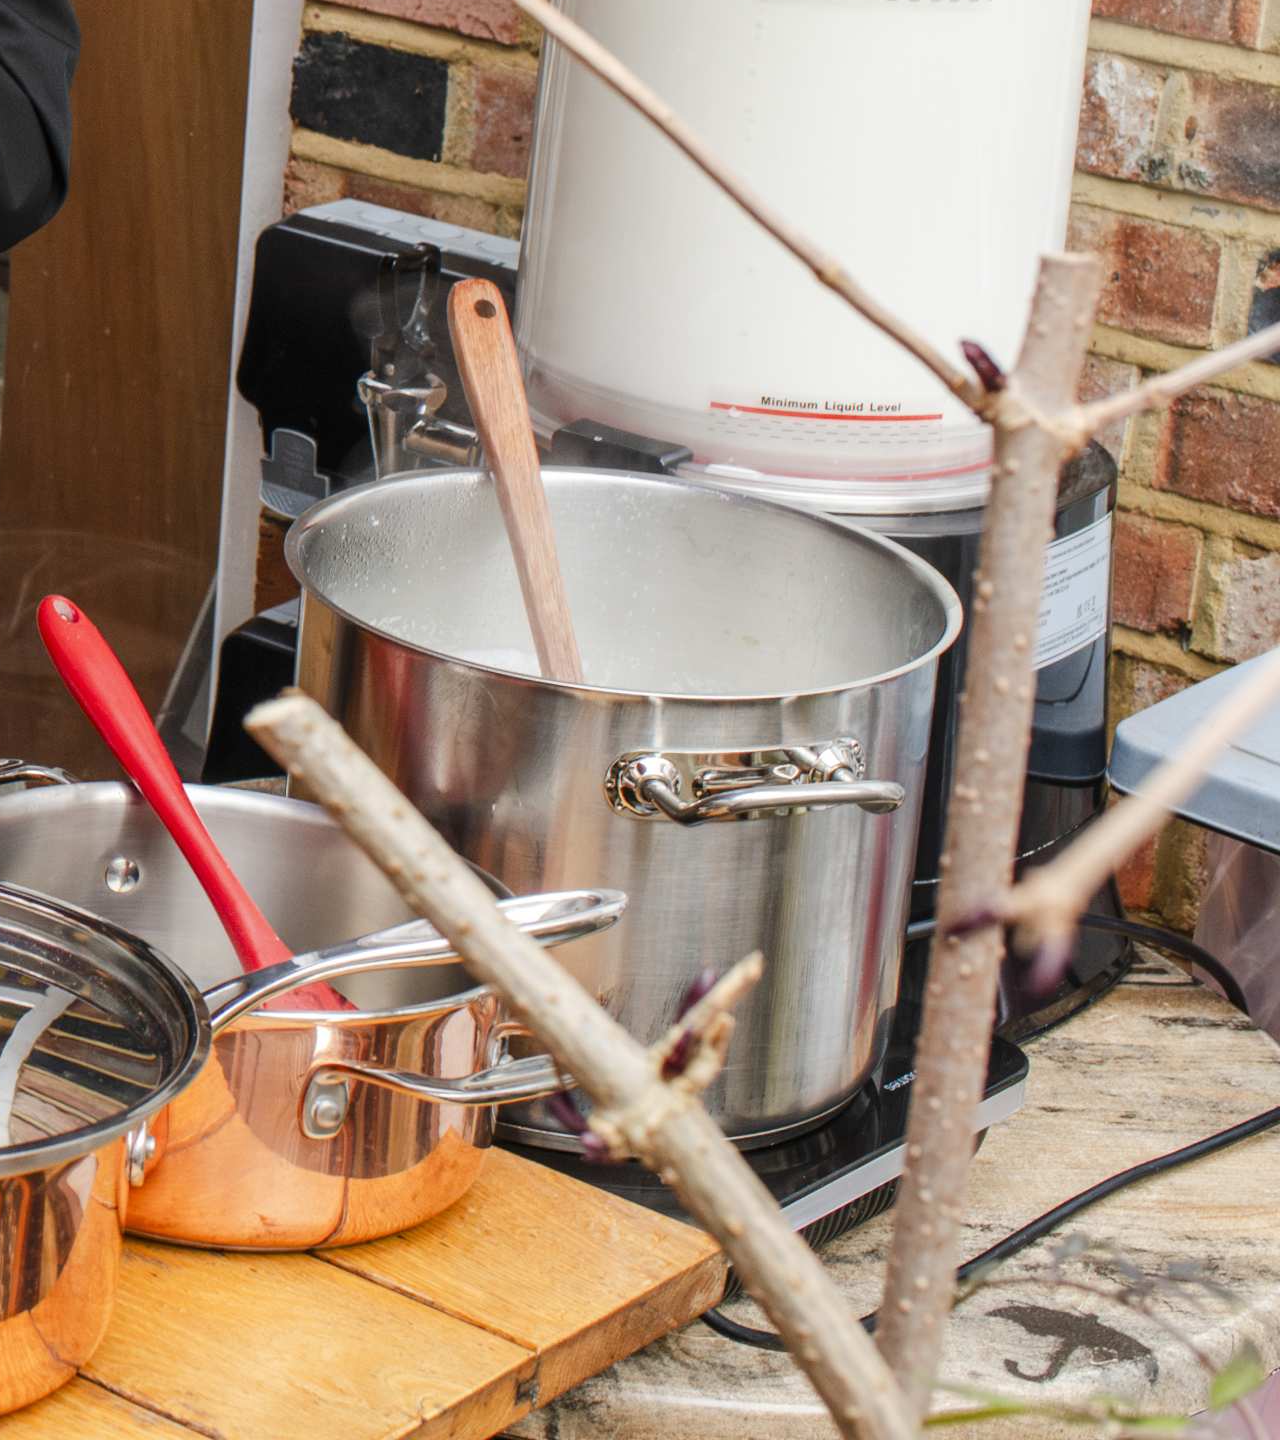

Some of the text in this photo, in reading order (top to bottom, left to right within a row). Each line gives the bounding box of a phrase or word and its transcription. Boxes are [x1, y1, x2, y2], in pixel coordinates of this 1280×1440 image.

[760, 396, 902, 413] Minimum Liquid Level
